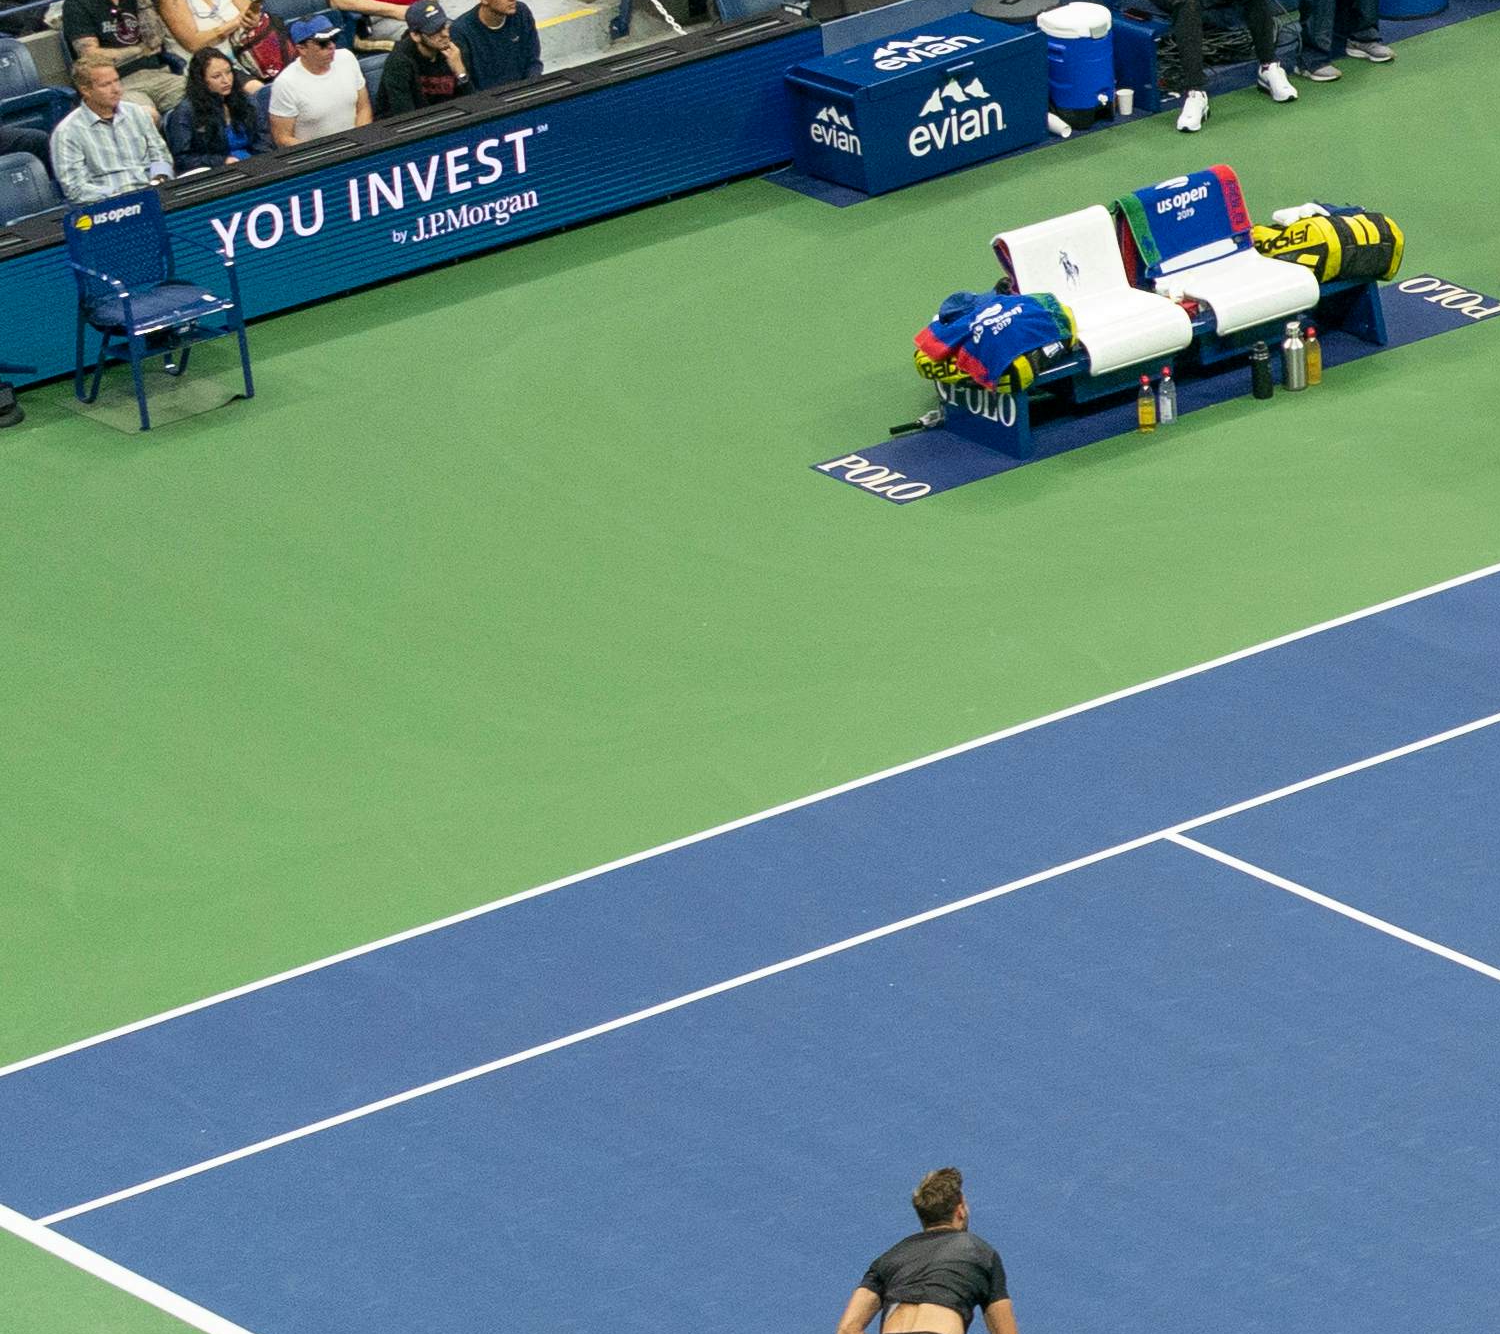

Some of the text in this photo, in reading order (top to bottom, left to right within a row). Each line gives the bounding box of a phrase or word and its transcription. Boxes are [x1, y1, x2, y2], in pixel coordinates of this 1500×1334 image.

[874, 35, 982, 71] evian
[810, 122, 863, 156] evian
[908, 101, 1004, 157] evian
[210, 188, 325, 258] YOU
[348, 126, 536, 223] INVEST
[1156, 196, 1172, 215] us
[1172, 185, 1207, 211] open
[94, 203, 143, 225] us open
[392, 187, 540, 246] by J.P.Morgan
[1177, 205, 1195, 221] 2019
[816, 453, 933, 503] POLO
